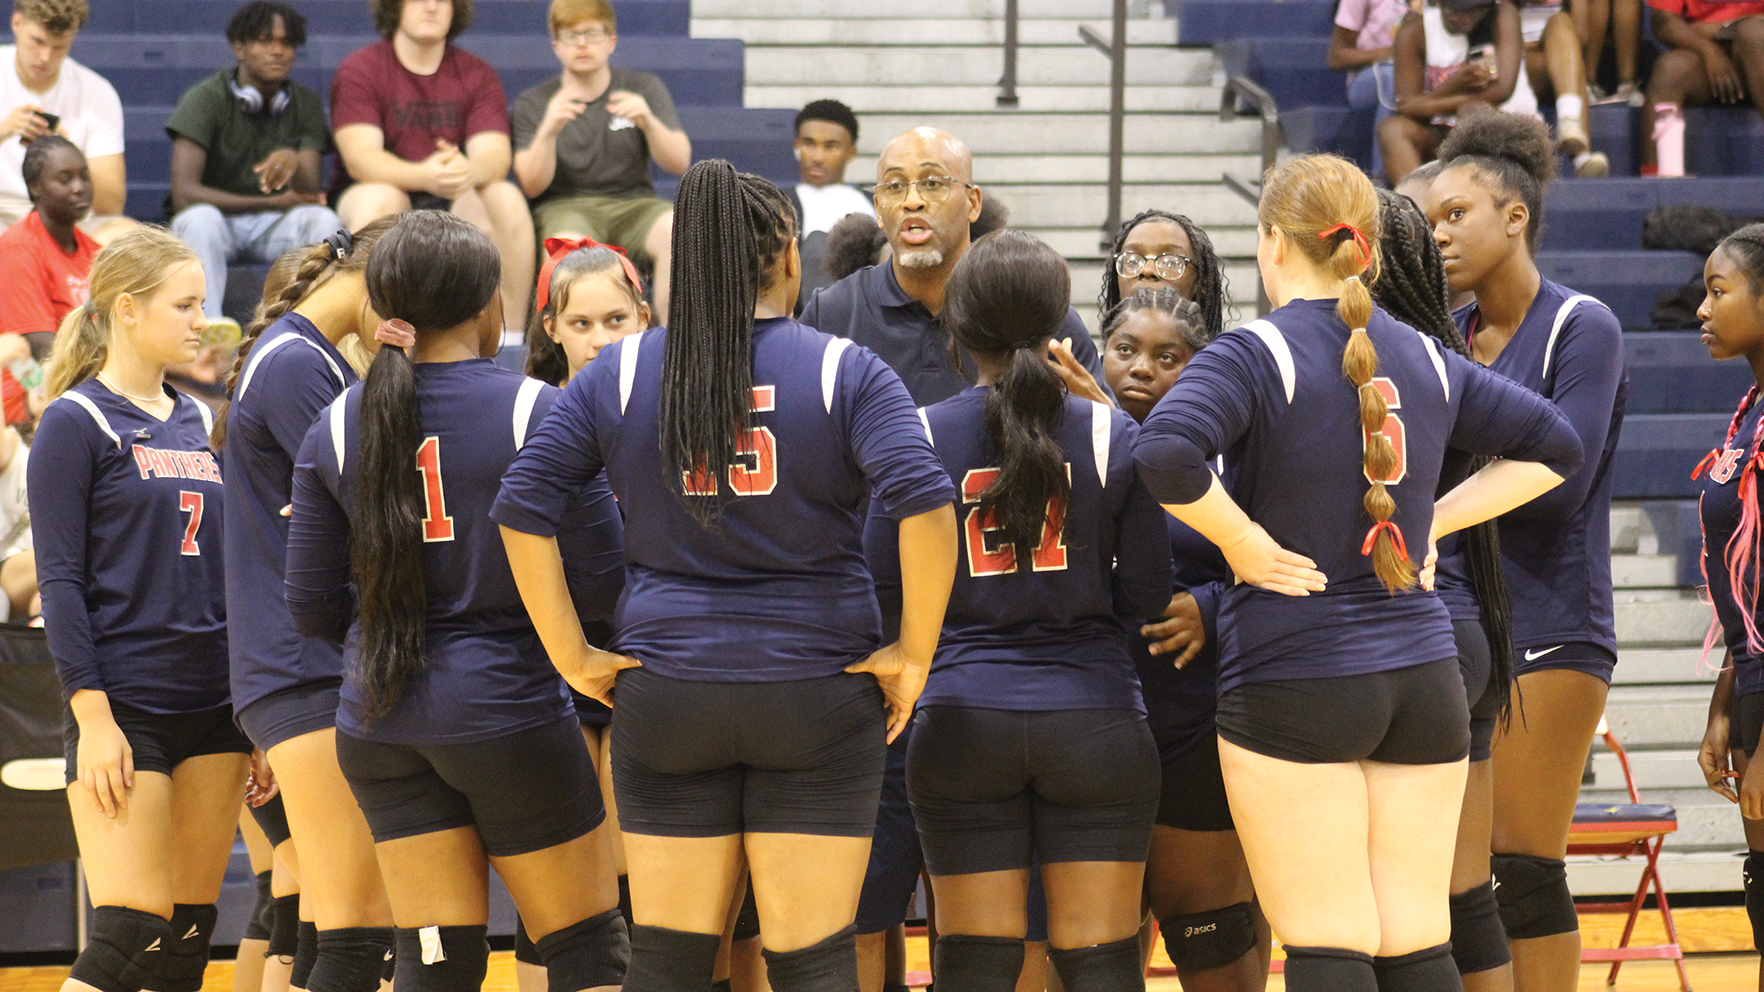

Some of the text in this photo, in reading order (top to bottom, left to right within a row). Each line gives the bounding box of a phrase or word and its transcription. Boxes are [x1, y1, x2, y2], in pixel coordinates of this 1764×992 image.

[1358, 377, 1407, 485] 6
[180, 490, 204, 556] 7
[416, 436, 455, 543] 1
[1193, 922, 1217, 935] asics
